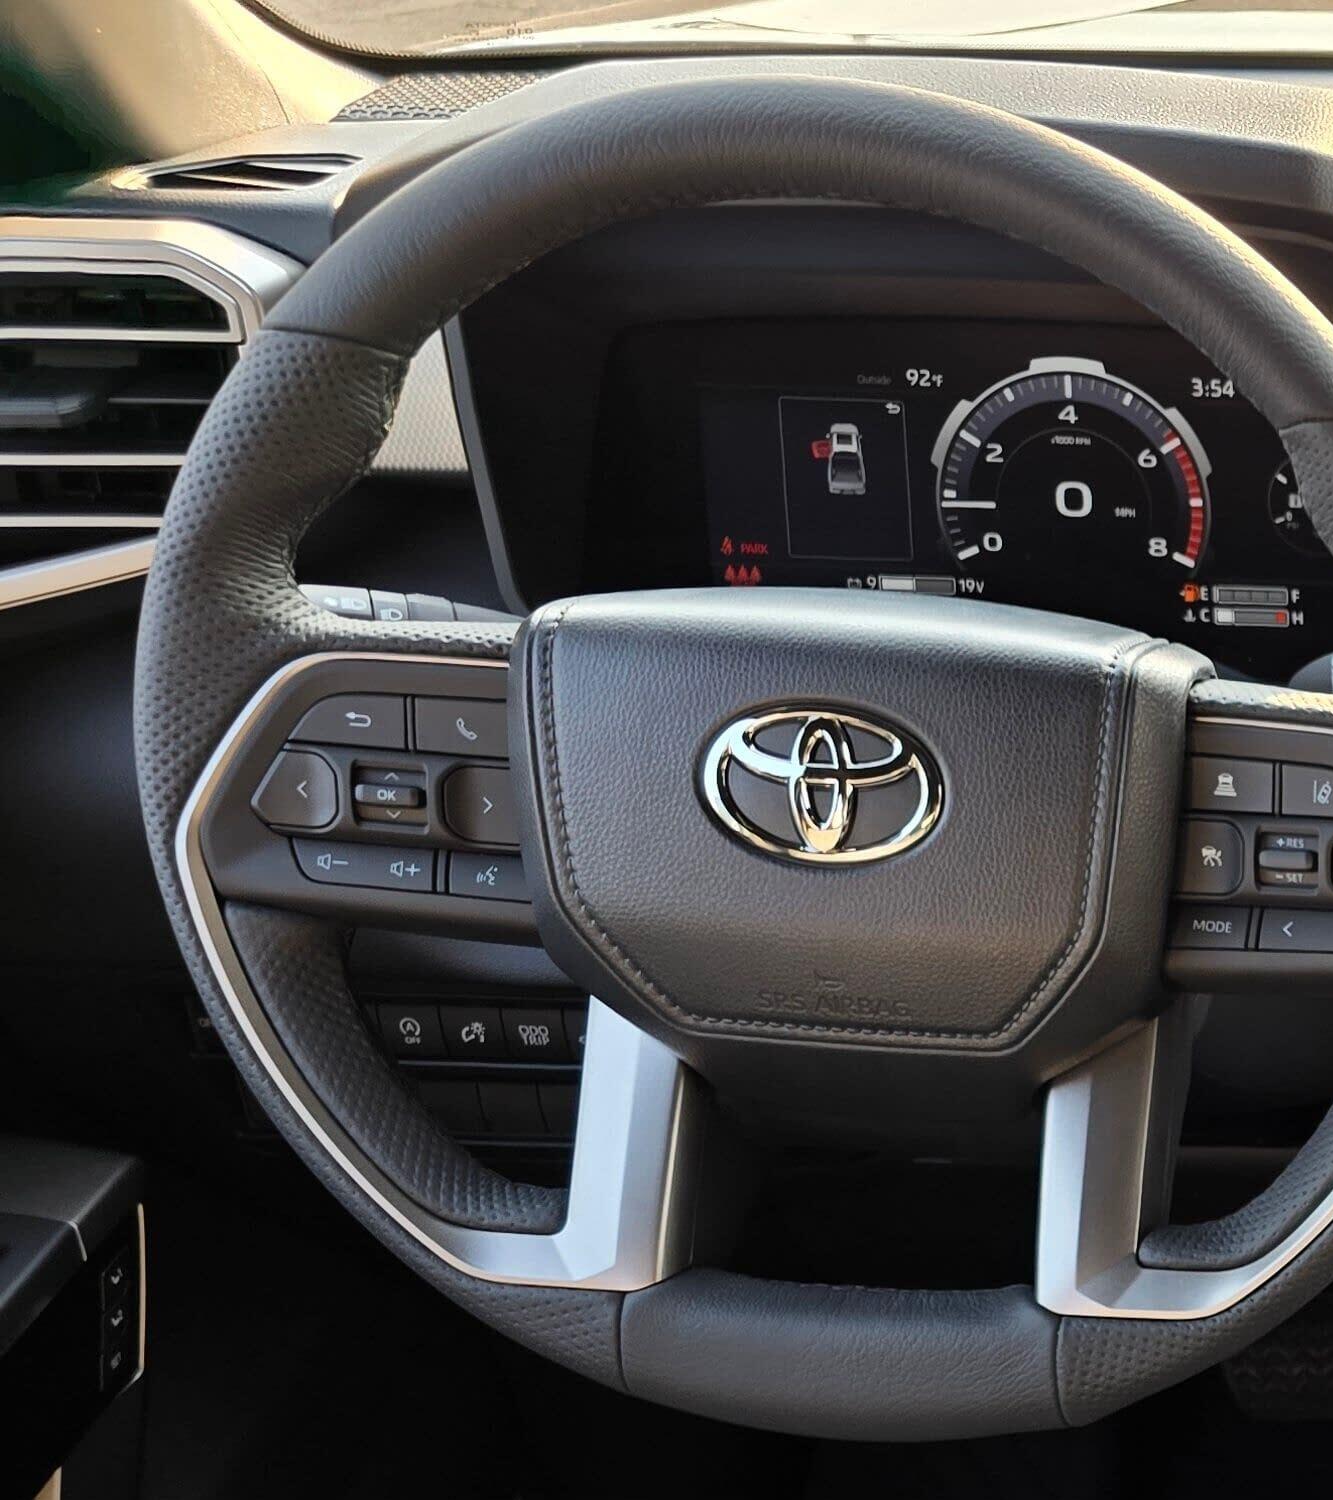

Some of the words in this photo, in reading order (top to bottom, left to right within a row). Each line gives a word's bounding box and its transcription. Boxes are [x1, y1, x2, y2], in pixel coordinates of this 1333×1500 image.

[1191, 377, 1235, 398] 3:54
[1058, 405, 1079, 424] 4
[986, 443, 1004, 463] 2
[1137, 448, 1157, 468] 6
[1055, 480, 1093, 518] 0
[741, 543, 768, 554] PARK
[983, 532, 1003, 552] 0
[1148, 537, 1168, 557] 8
[866, 576, 877, 590] 9
[958, 579, 985, 594] 19V
[1200, 587, 1209, 601] E
[1199, 608, 1210, 622] C
[1292, 611, 1304, 626] H
[377, 790, 396, 801] OK
[1192, 919, 1232, 934] MODE
